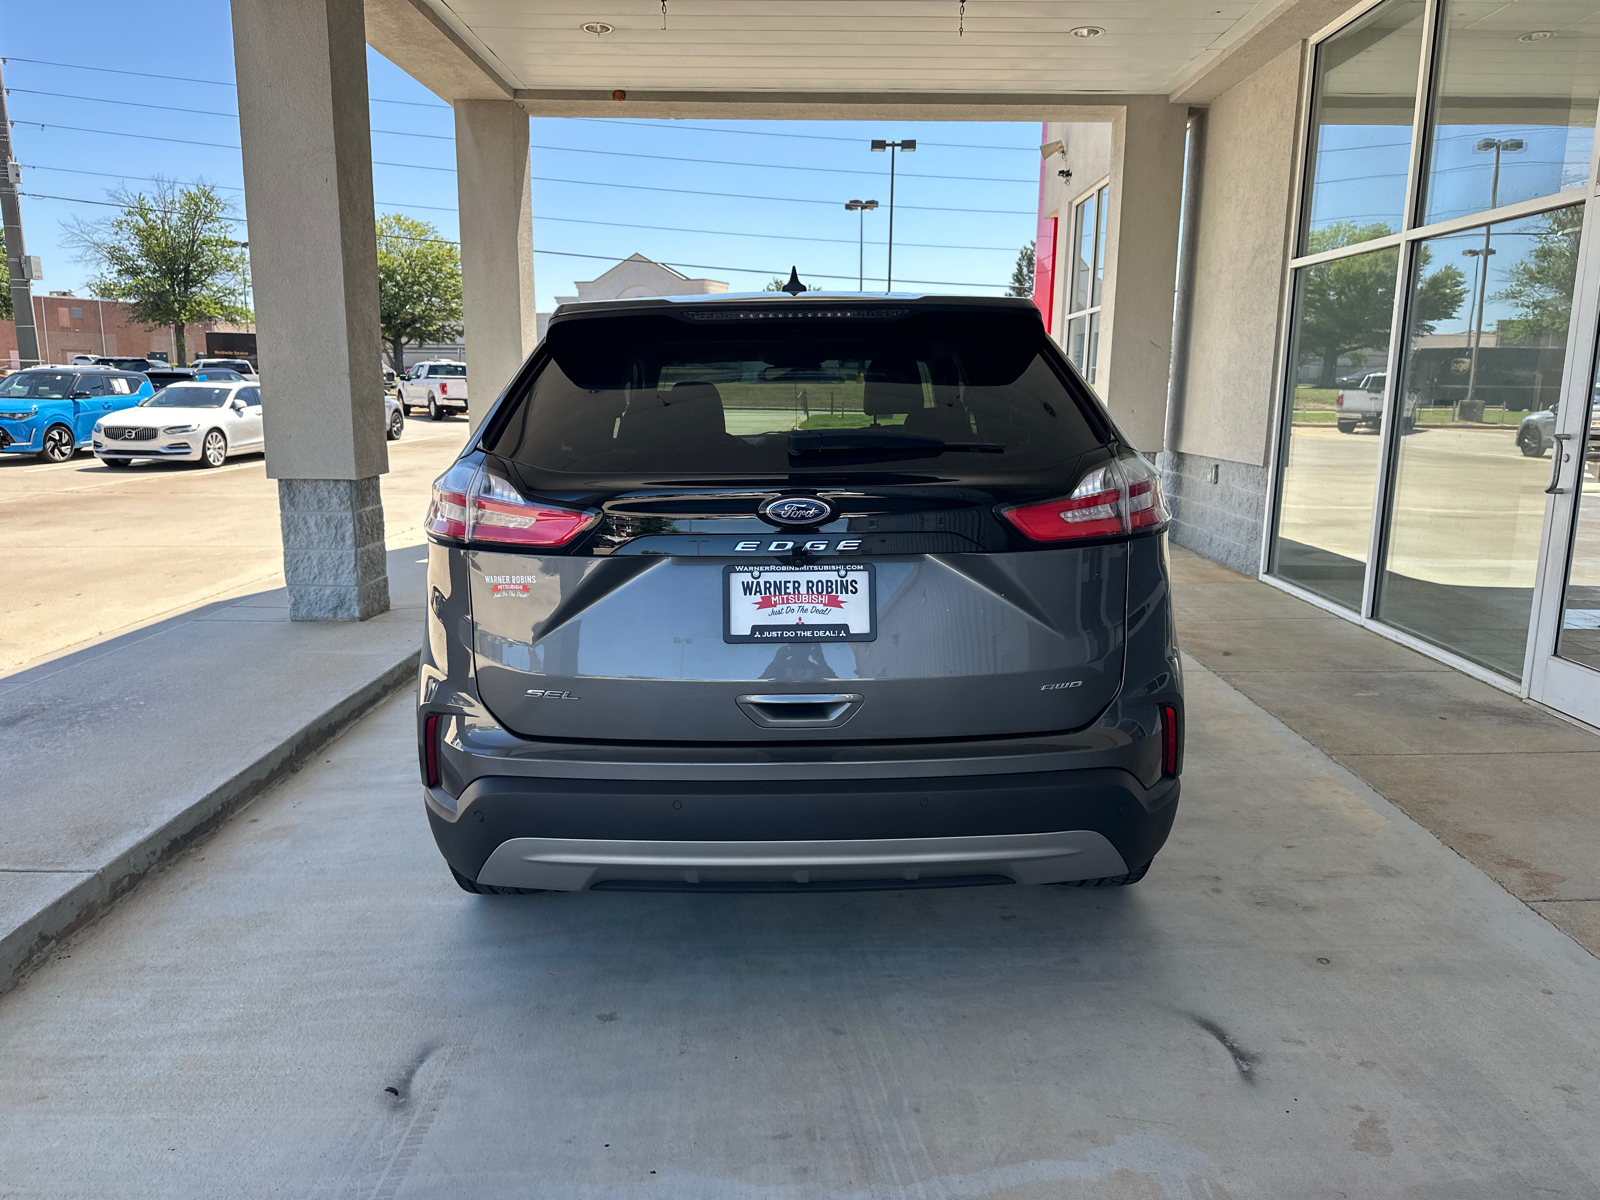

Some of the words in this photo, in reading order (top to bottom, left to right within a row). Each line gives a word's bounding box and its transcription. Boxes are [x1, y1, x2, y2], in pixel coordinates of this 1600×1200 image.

[779, 503, 819, 518] Ford
[734, 540, 863, 552] EDGE
[485, 576, 510, 584] WARNER
[512, 575, 537, 584] ROBINS
[741, 580, 801, 596] WARNER
[806, 579, 859, 595] ROBINS
[771, 595, 828, 605] MITSUBISHI
[768, 606, 784, 617] Just
[785, 606, 795, 614] Do
[796, 605, 809, 614] The
[810, 606, 832, 616] Deal!
[1040, 681, 1083, 691] AWD
[524, 688, 581, 700] SEL
